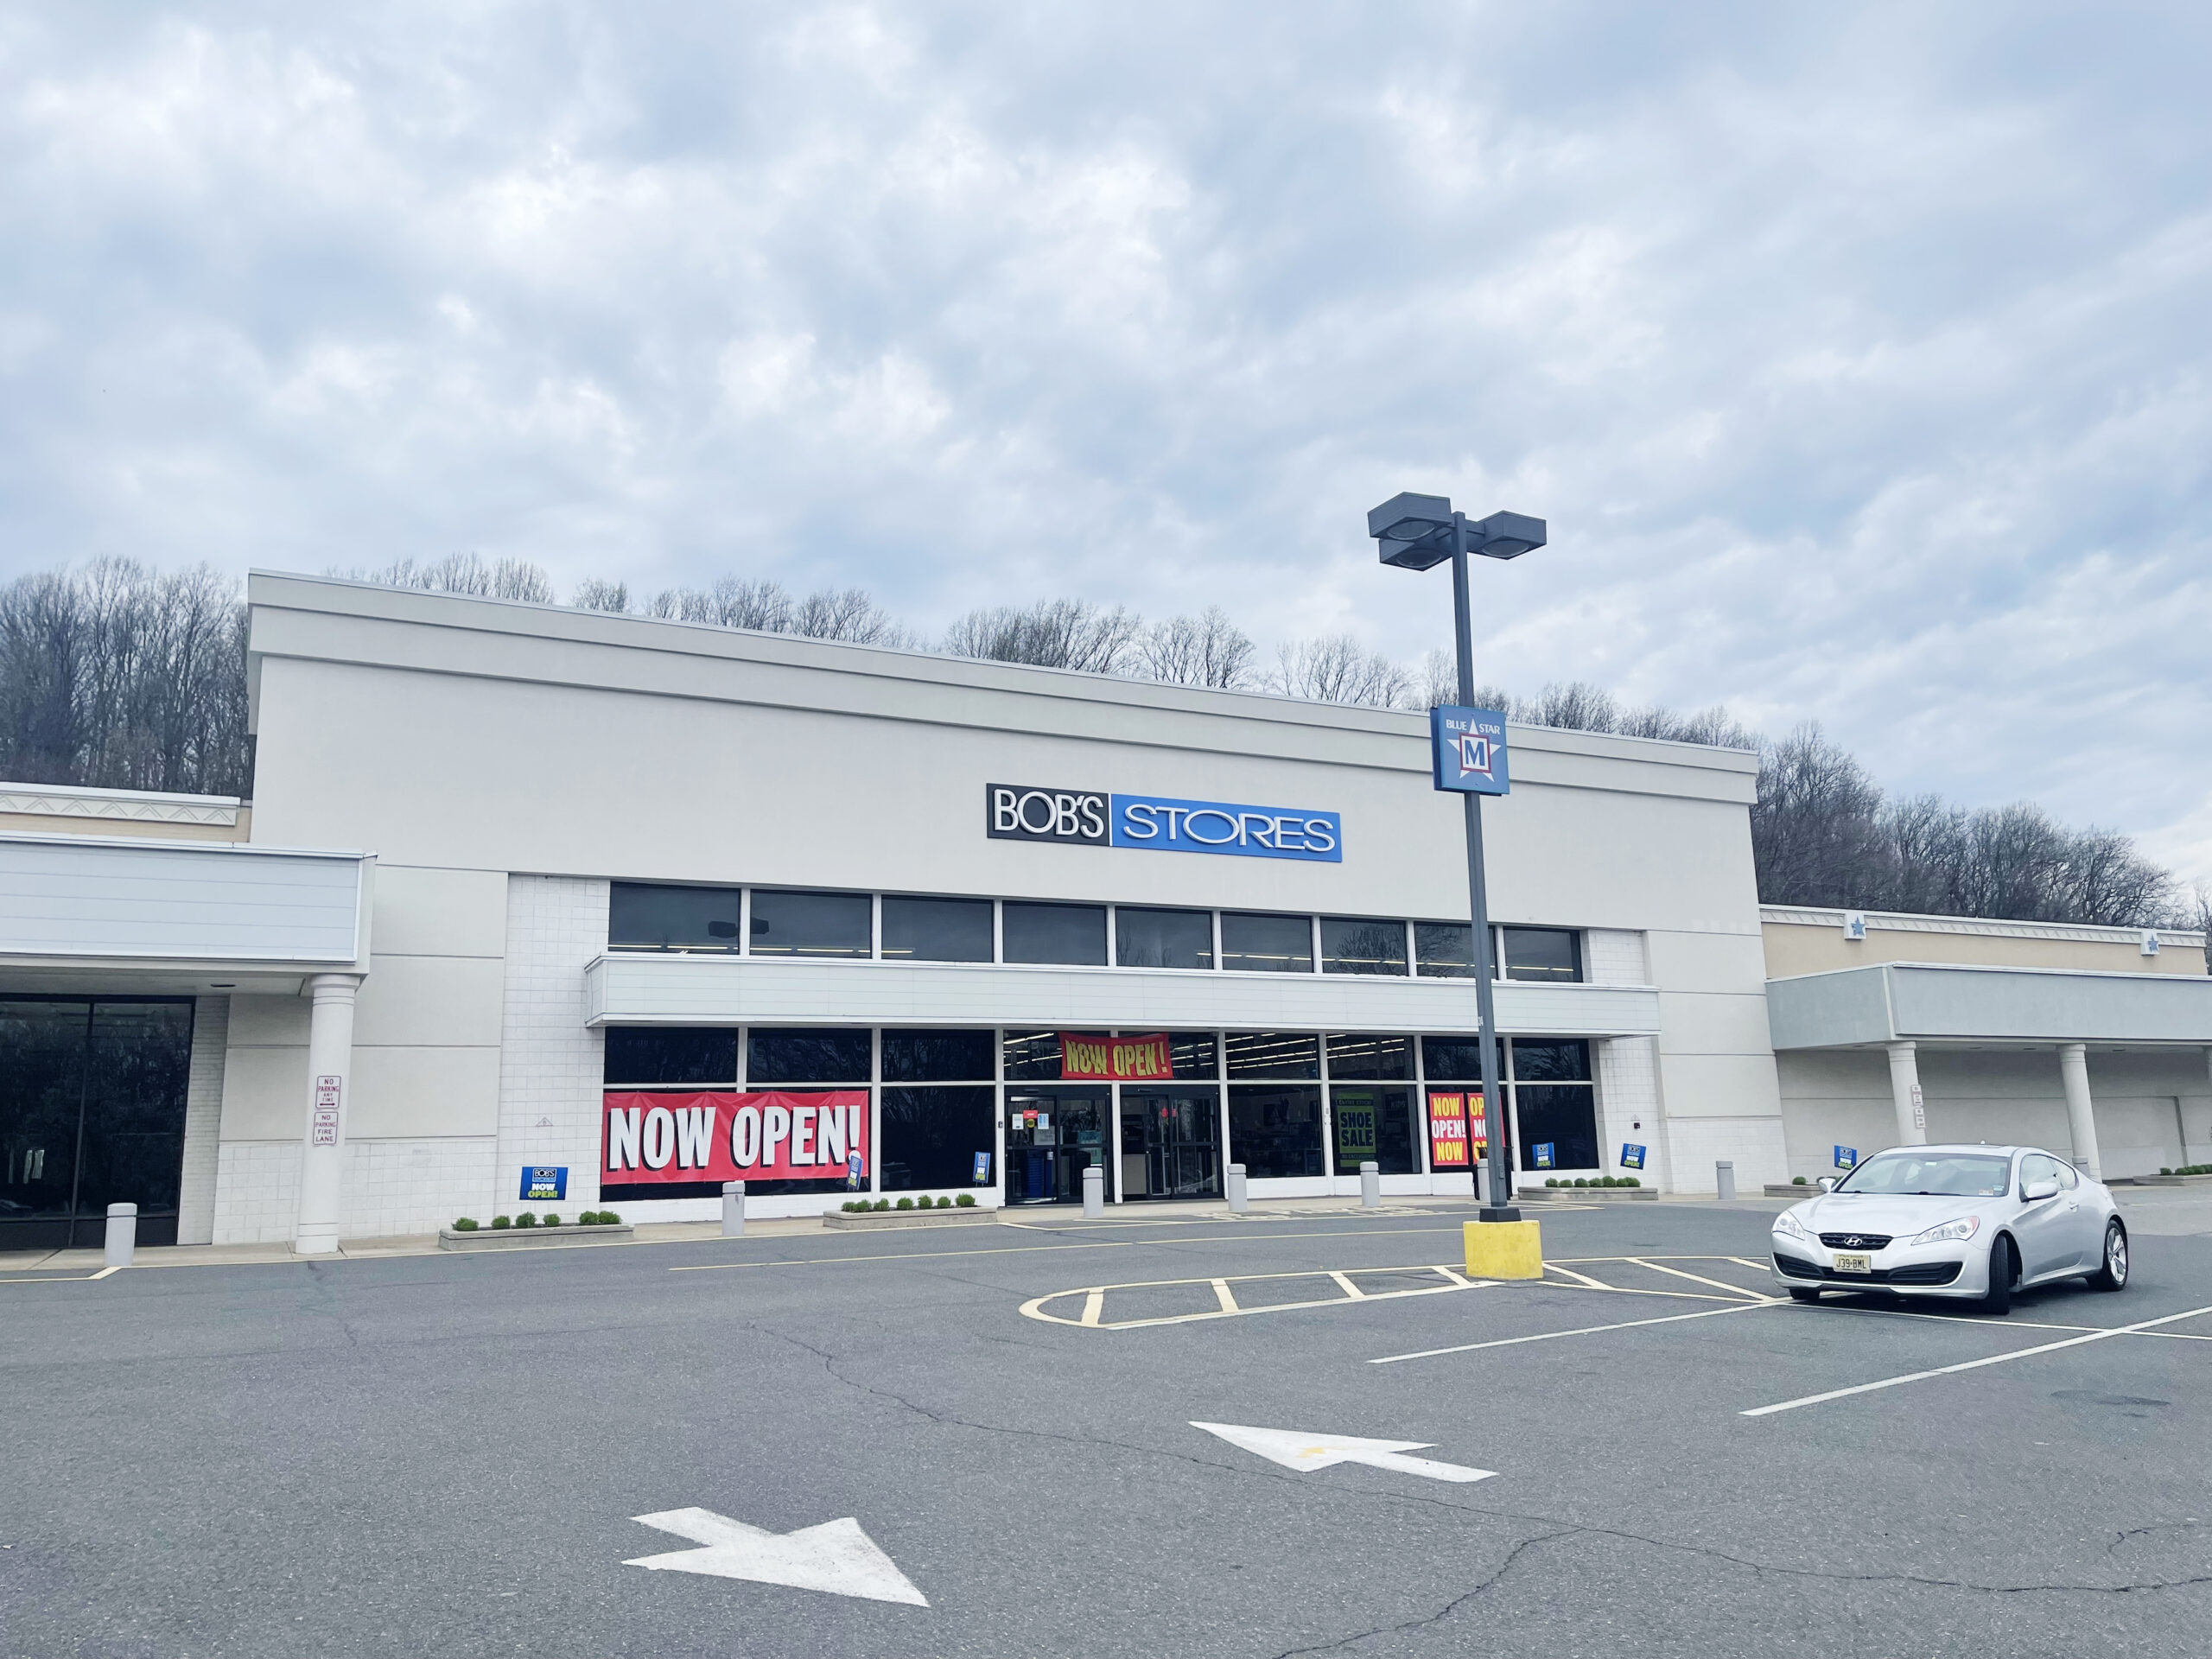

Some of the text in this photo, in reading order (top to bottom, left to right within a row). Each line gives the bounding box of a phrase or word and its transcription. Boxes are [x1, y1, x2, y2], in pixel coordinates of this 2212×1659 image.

[1446, 719, 1501, 735] BLUE STAR
[1465, 740, 1485, 766] M
[993, 788, 1336, 852] BOB'S STORES
[1065, 1039, 1168, 1077] NOW OPEN!
[1433, 1097, 1460, 1116] NOW
[1340, 1111, 1373, 1128] SHOE
[1431, 1119, 1466, 1139] OPEN!
[607, 1105, 861, 1172] NOW OPEN!
[1341, 1128, 1374, 1147] SALE
[1436, 1141, 1463, 1161] NOW
